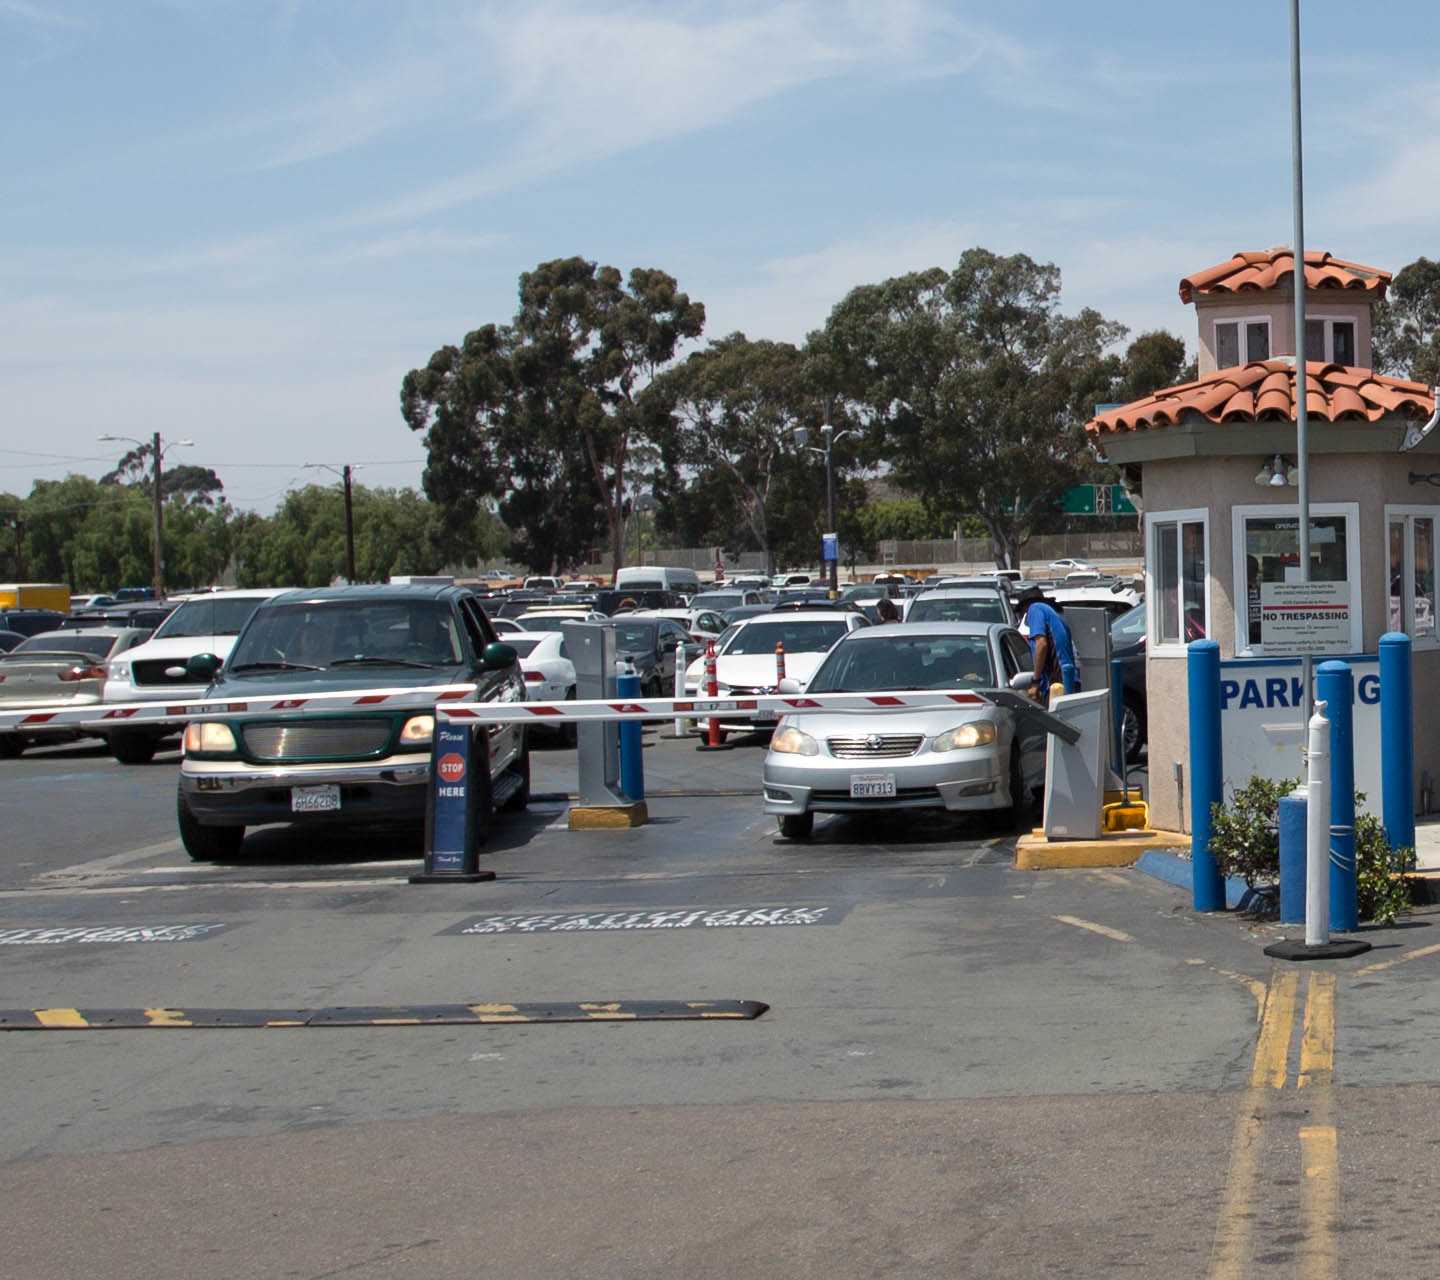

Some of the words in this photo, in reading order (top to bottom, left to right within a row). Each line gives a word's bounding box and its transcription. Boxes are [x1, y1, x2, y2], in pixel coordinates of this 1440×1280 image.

[1263, 612, 1277, 621] NO
[1281, 611, 1349, 621] TRESPASSING
[441, 763, 464, 773] STOP
[439, 787, 464, 797] HERE
